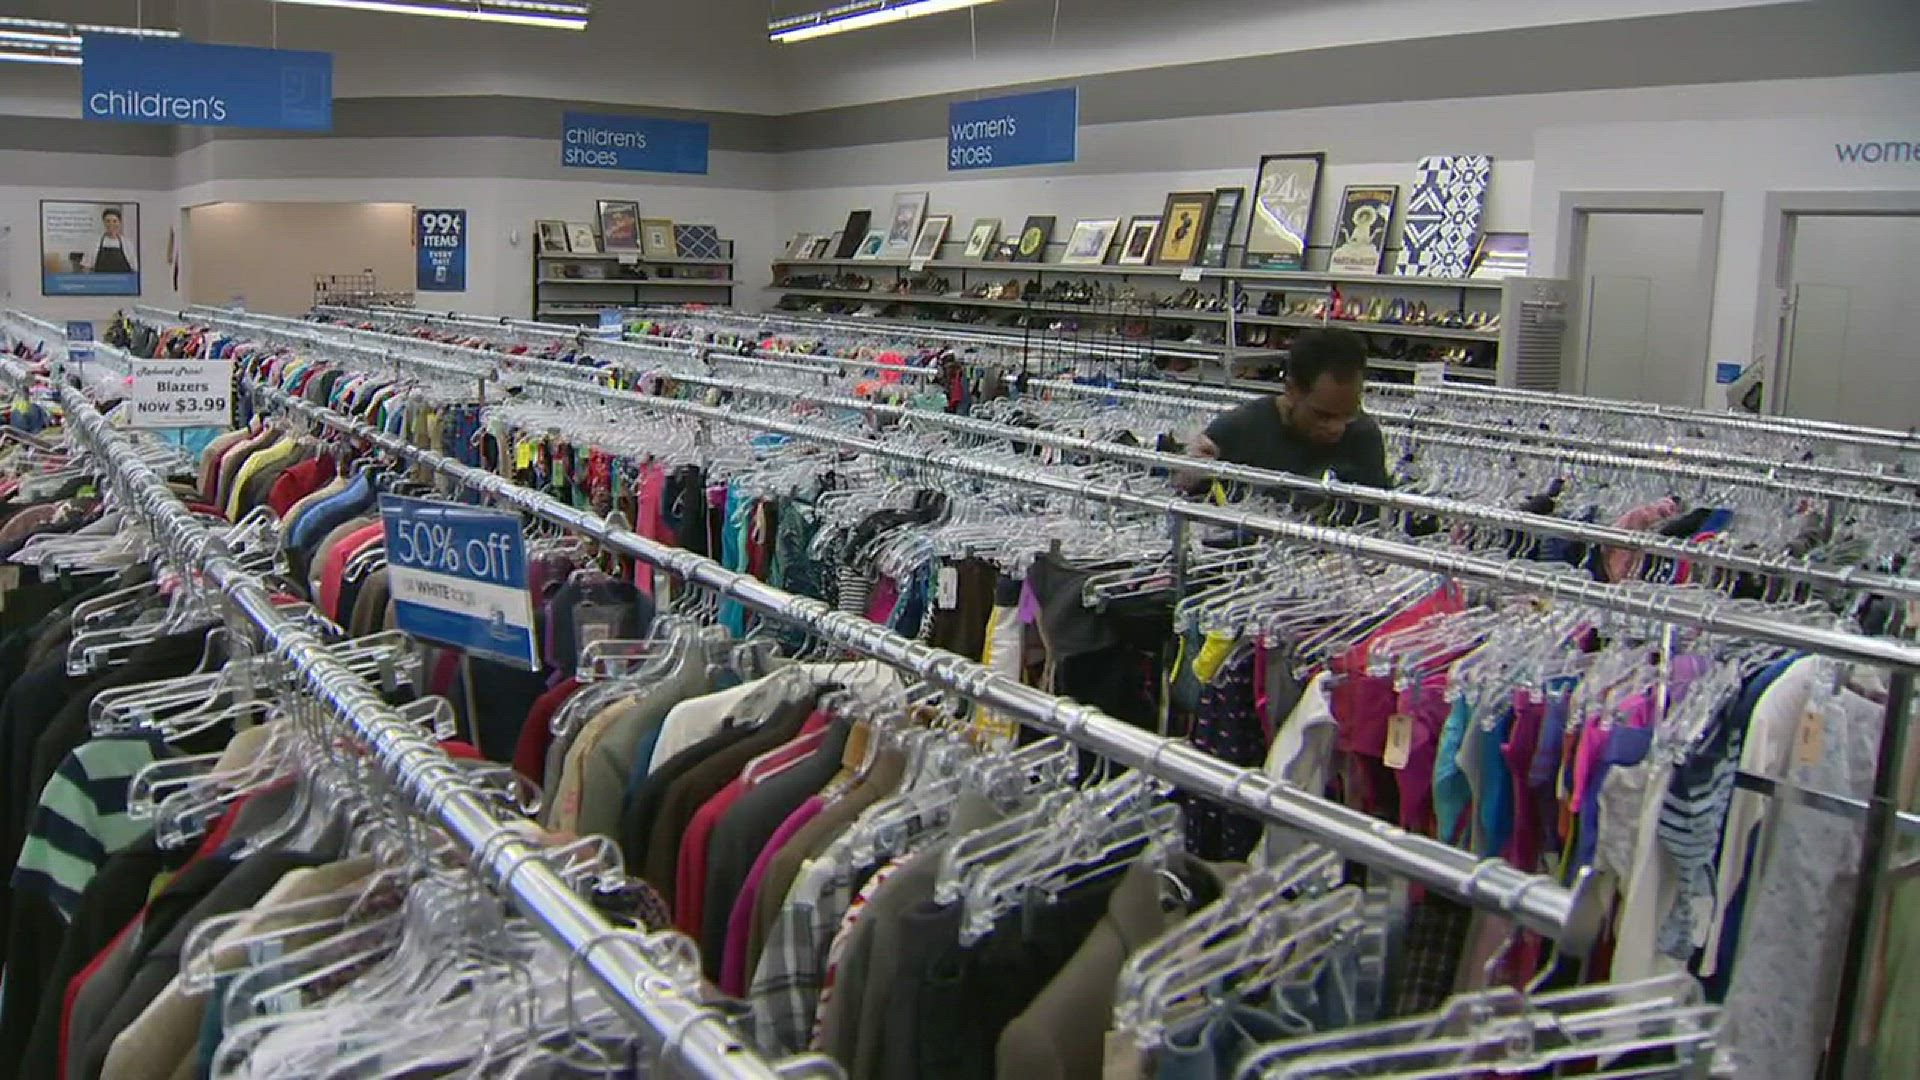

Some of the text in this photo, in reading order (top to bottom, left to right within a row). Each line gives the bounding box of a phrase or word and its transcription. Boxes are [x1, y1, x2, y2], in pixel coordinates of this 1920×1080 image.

[90, 90, 227, 121] children's
[566, 127, 647, 149] children's
[951, 115, 1017, 140] women's
[565, 147, 618, 166] shoes
[951, 145, 993, 167] shoes
[423, 213, 461, 234] 99¢
[424, 235, 458, 248] ITEMS
[157, 381, 209, 393] Blazers
[138, 397, 226, 415] NOW $3.99
[398, 519, 512, 581] 50% off
[415, 579, 450, 600] WHITE
